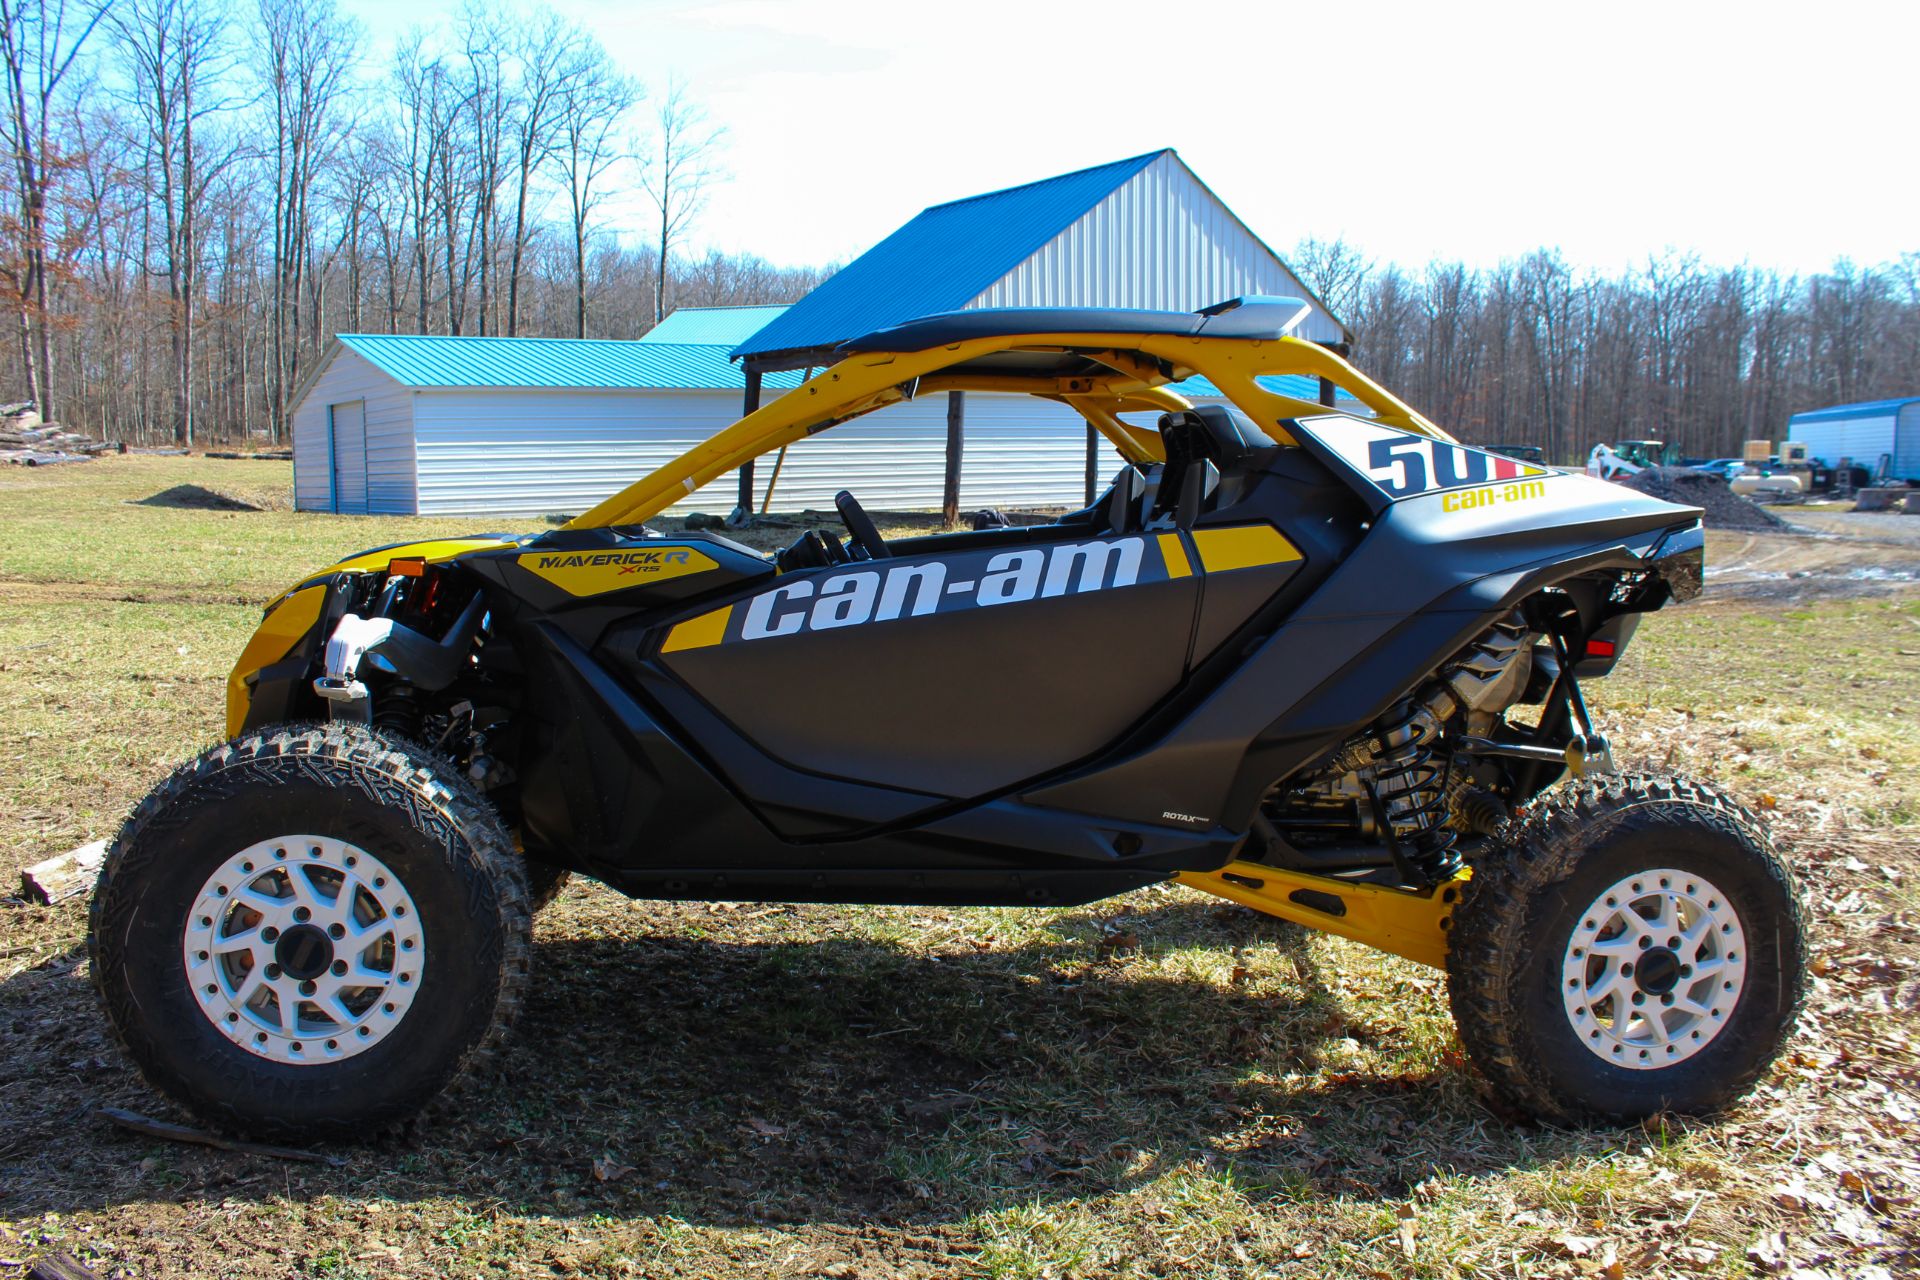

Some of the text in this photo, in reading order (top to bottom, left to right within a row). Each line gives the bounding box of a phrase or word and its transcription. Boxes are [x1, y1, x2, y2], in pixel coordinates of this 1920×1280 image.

[1442, 481, 1545, 513] can-am
[538, 551, 690, 569] MAVERICK R
[617, 565, 661, 576] XRS
[742, 537, 1144, 641] can-am
[1162, 811, 1196, 823] ROTAX
